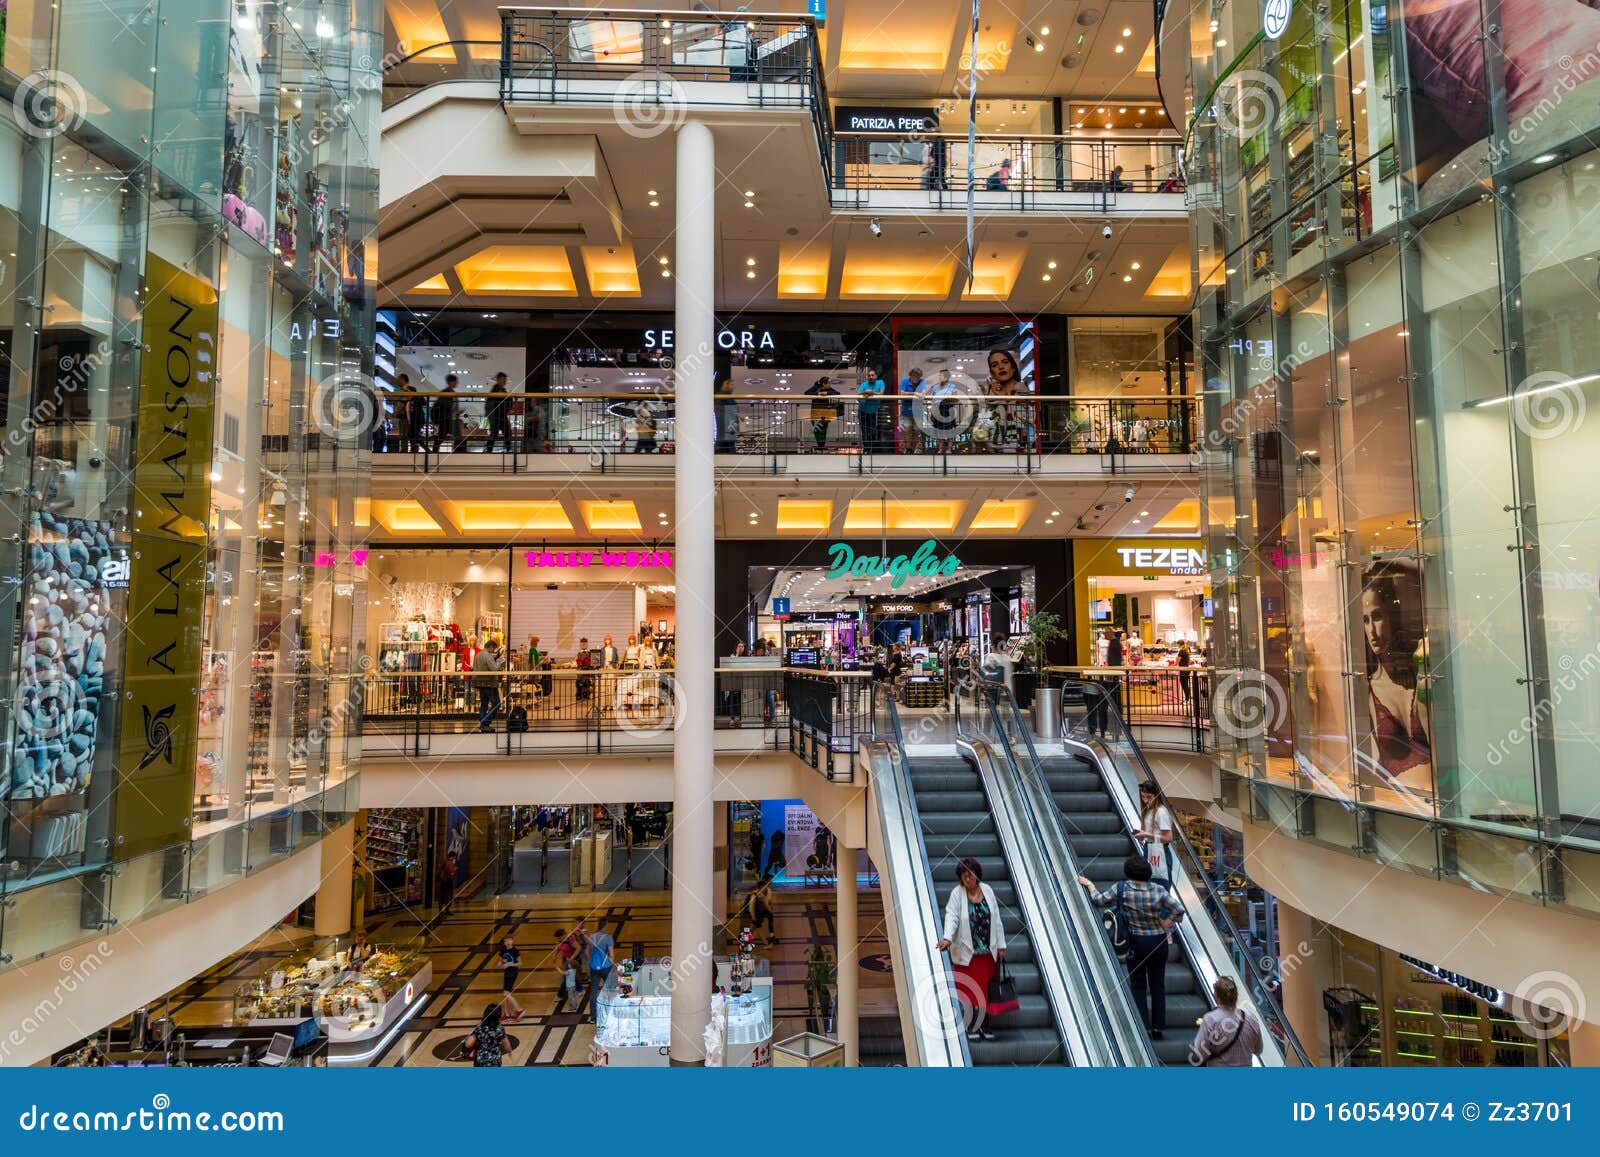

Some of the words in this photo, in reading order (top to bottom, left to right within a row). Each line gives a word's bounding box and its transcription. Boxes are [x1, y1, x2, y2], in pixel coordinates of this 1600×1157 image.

[851, 116, 896, 129] PATRIZIA
[898, 117, 924, 130] PEPE
[644, 329, 776, 349] SEORA
[157, 296, 195, 537] MAISON
[523, 551, 595, 568] TALLY
[826, 540, 960, 588] Douglas
[155, 556, 182, 618] LA
[836, 612, 852, 620] Dior
